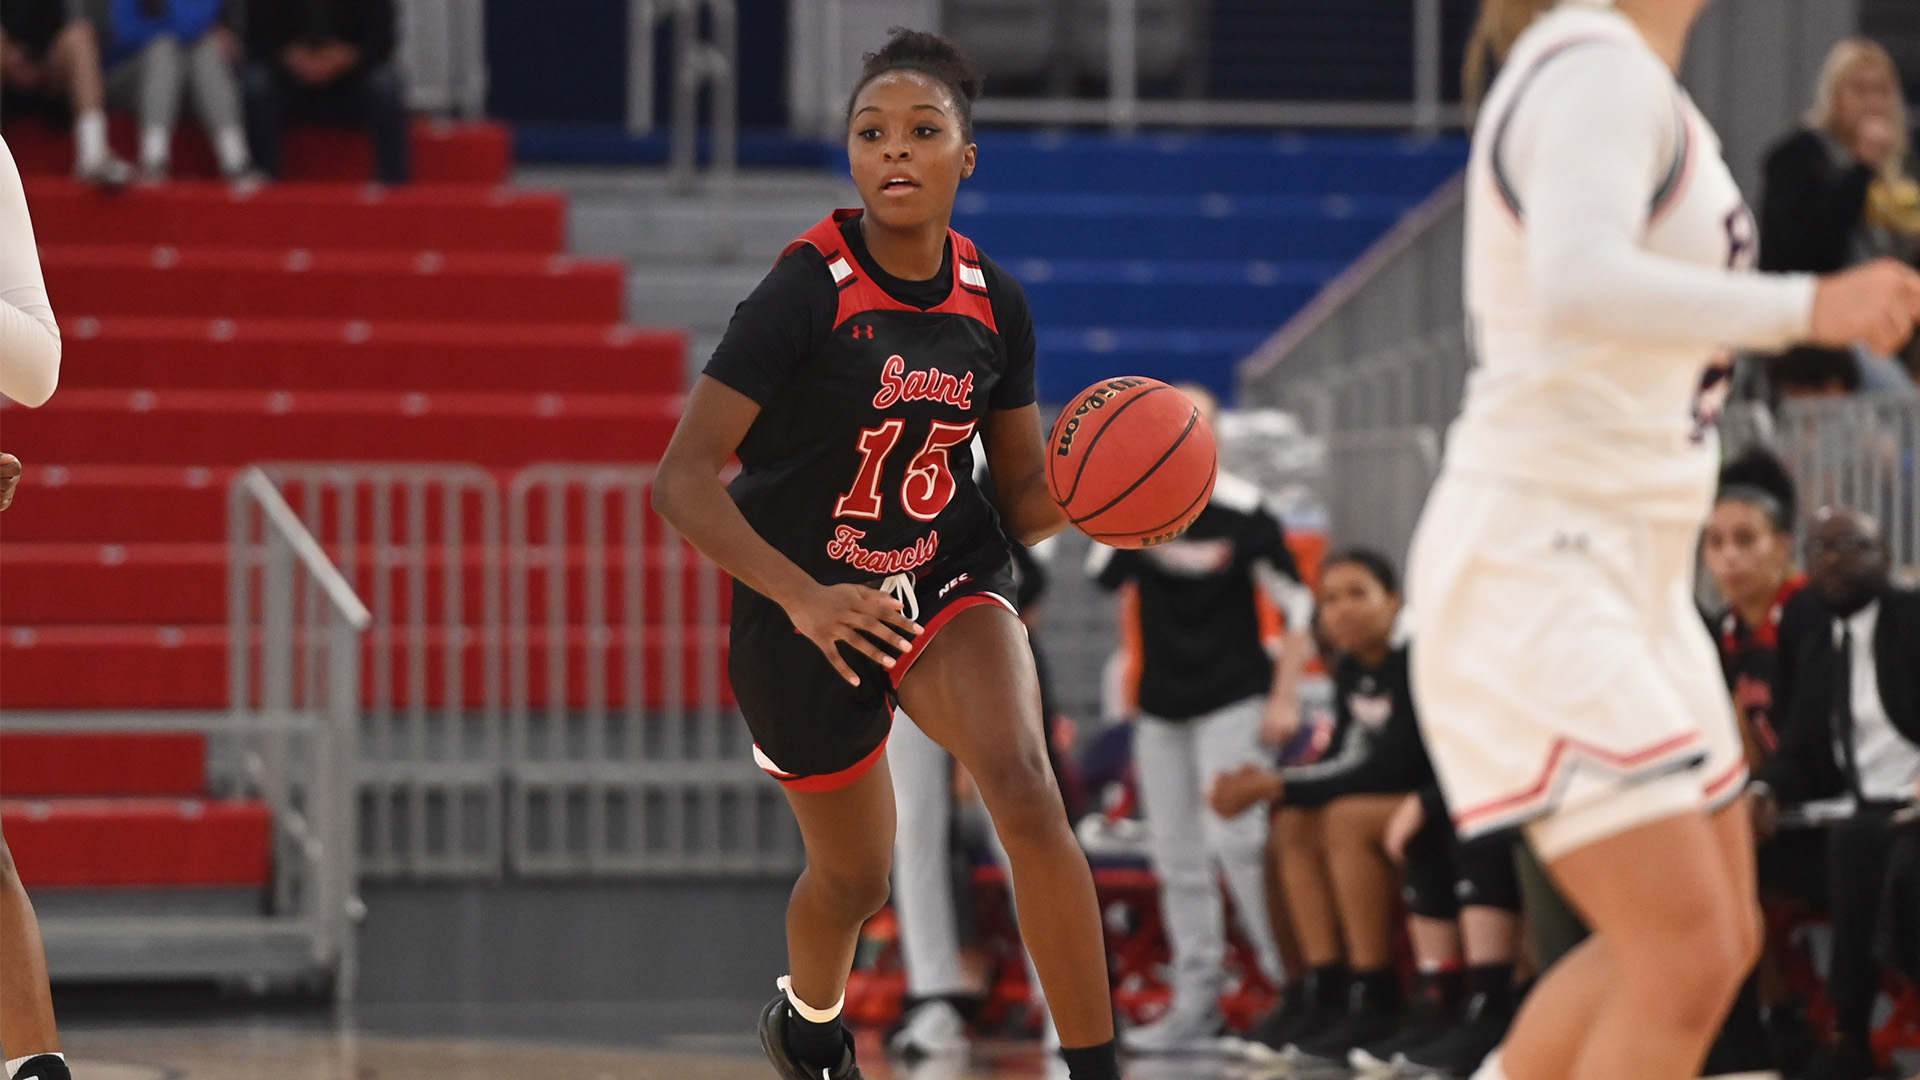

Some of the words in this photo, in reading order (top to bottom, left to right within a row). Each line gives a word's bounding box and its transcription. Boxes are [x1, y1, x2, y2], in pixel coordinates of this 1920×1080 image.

[872, 354, 974, 410] Saint
[831, 417, 979, 522] 15
[826, 523, 939, 574] Francis
[938, 572, 969, 599] NEC
